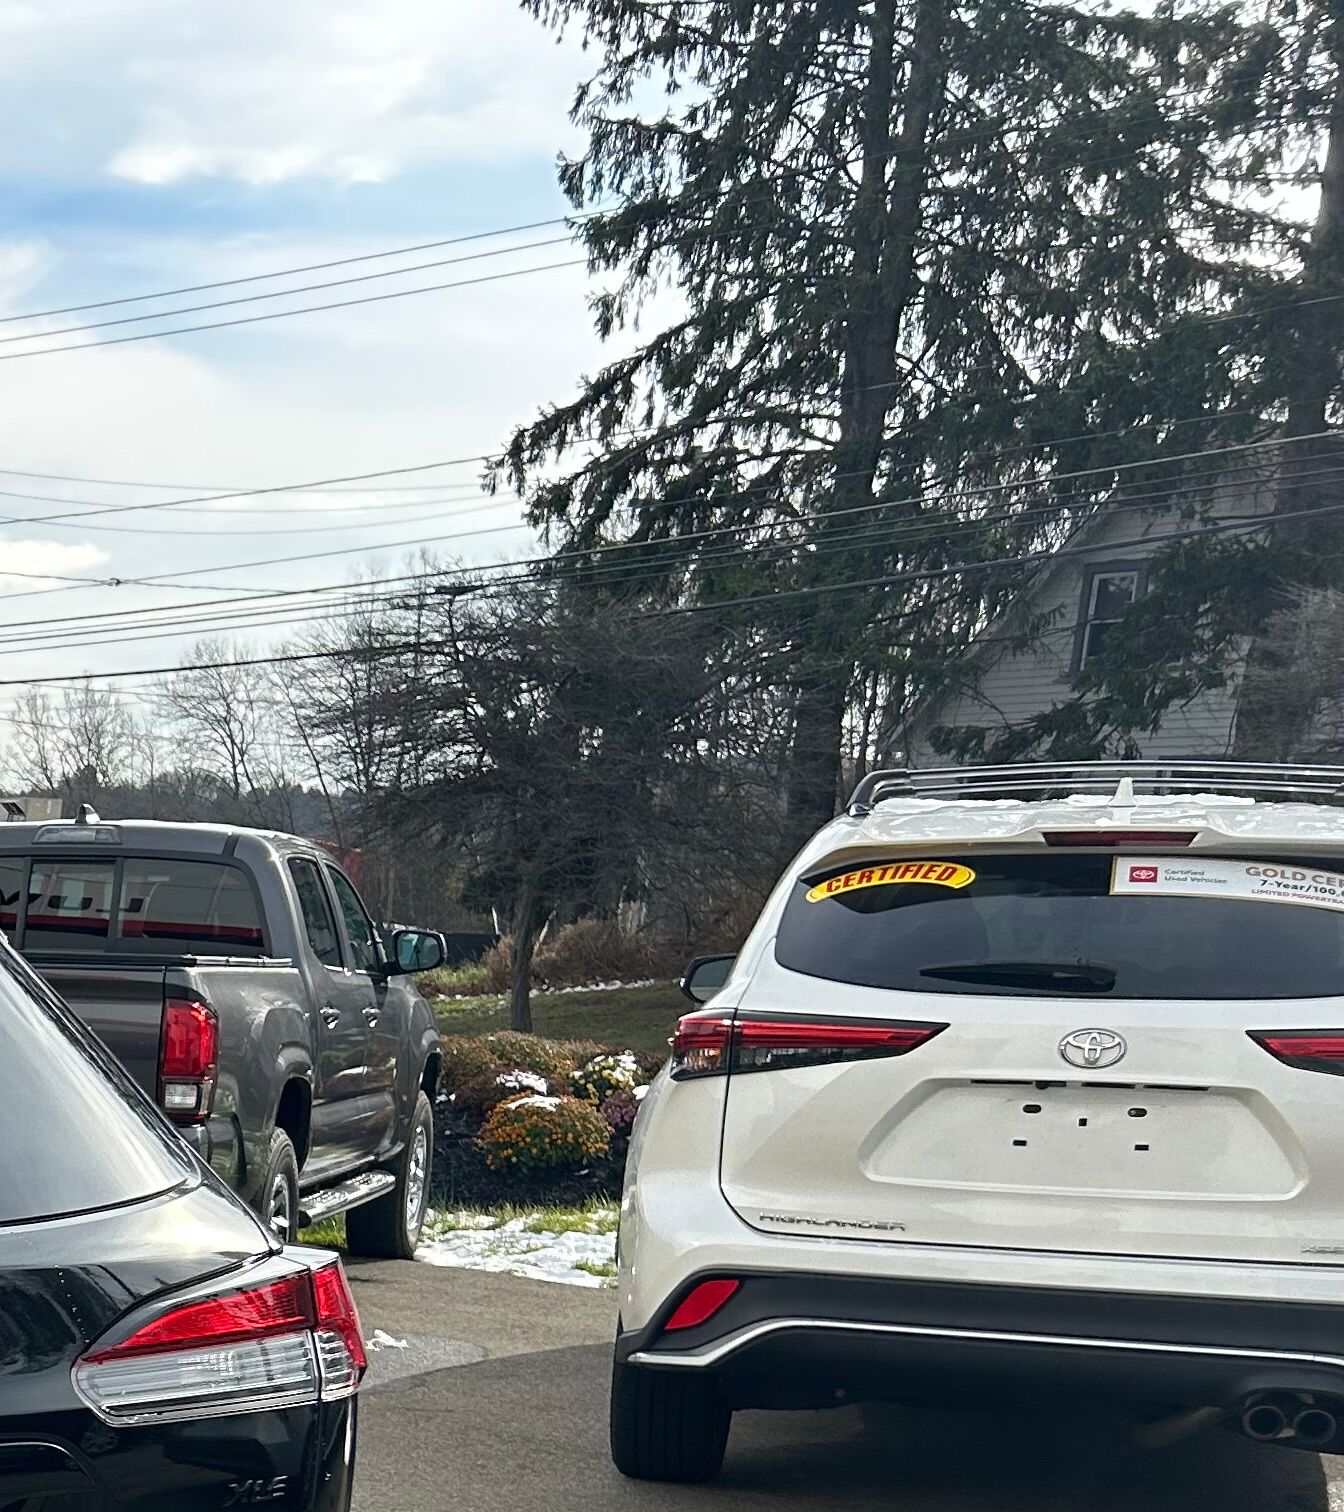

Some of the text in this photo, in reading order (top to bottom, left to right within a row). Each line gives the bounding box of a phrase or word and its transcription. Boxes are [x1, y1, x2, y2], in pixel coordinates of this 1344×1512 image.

[826, 863, 958, 893] CERTIFIED
[1246, 866, 1306, 881] GOLD
[759, 1213, 906, 1231] HIGHLANDER
[223, 1475, 288, 1507] XLE
